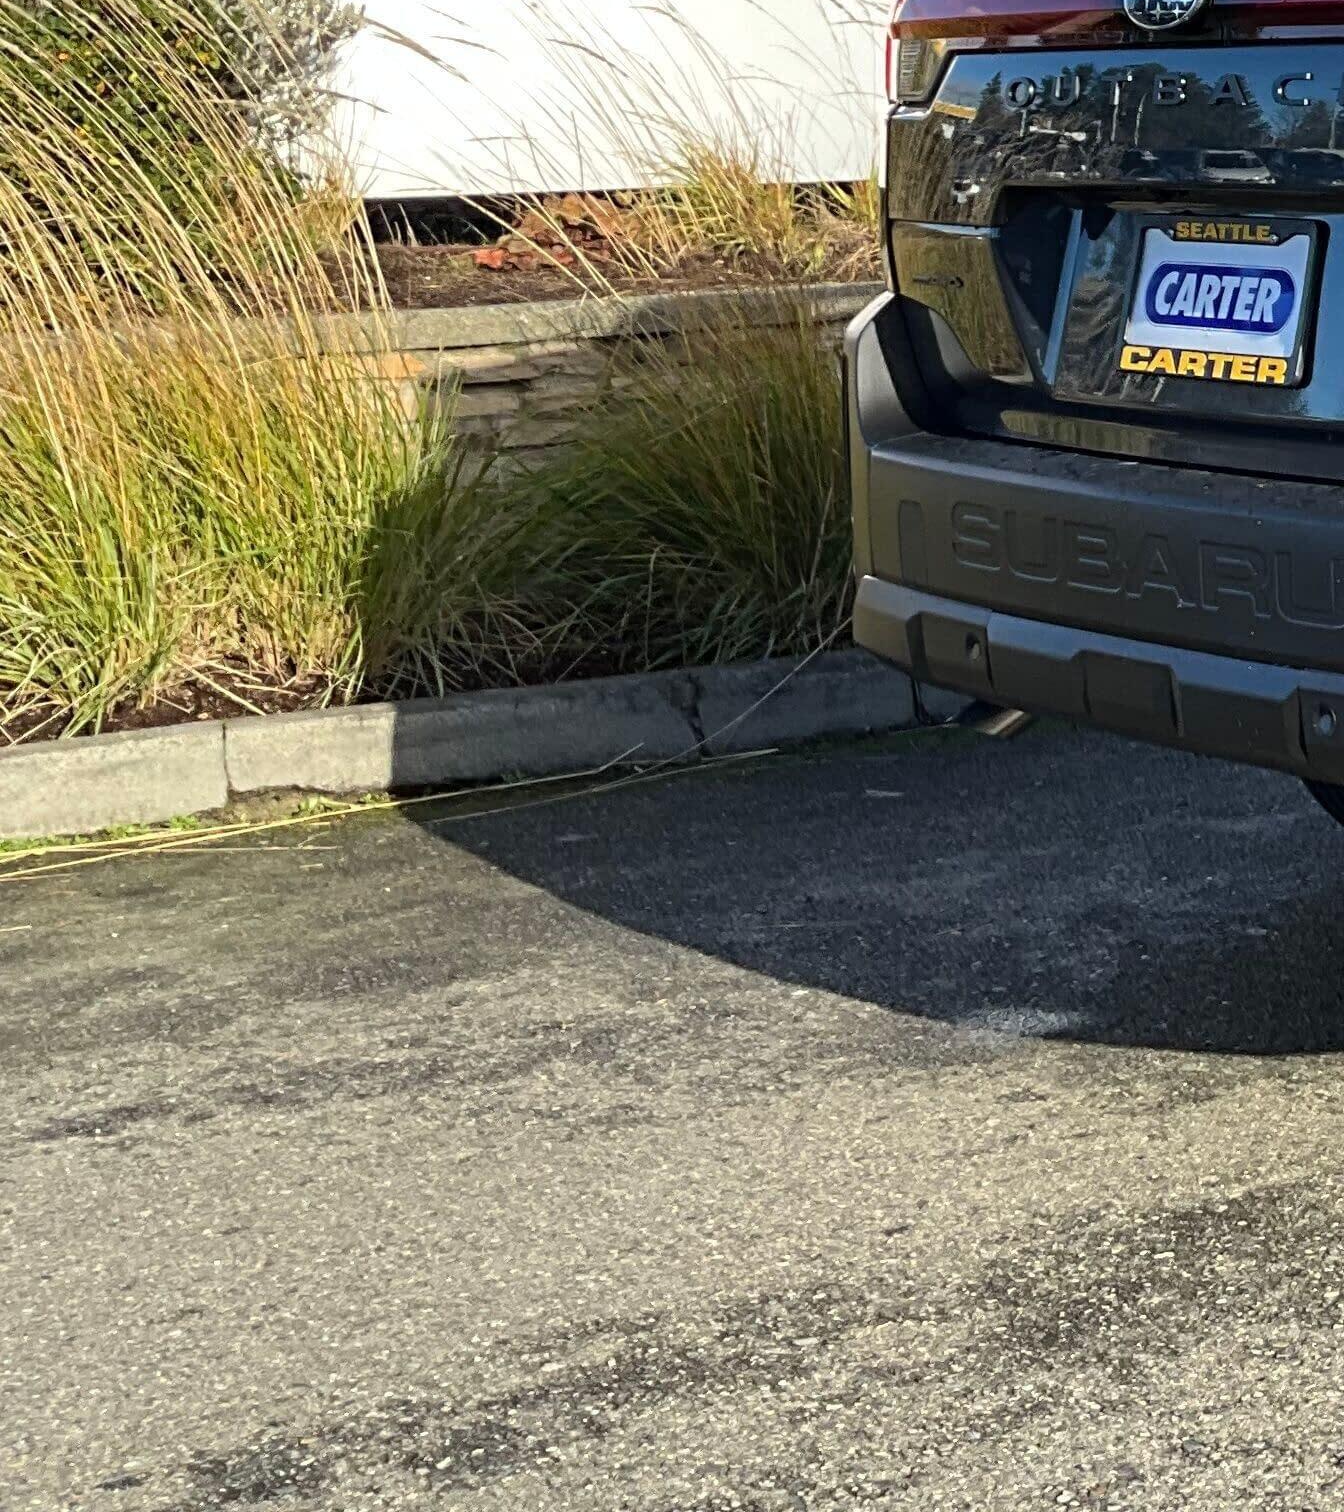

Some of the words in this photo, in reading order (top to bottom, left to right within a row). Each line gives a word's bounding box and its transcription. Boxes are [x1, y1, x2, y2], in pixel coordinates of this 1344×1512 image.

[1175, 220, 1272, 241] SEATTLE
[1154, 270, 1282, 324] CARTER
[1119, 345, 1288, 385] CARTER
